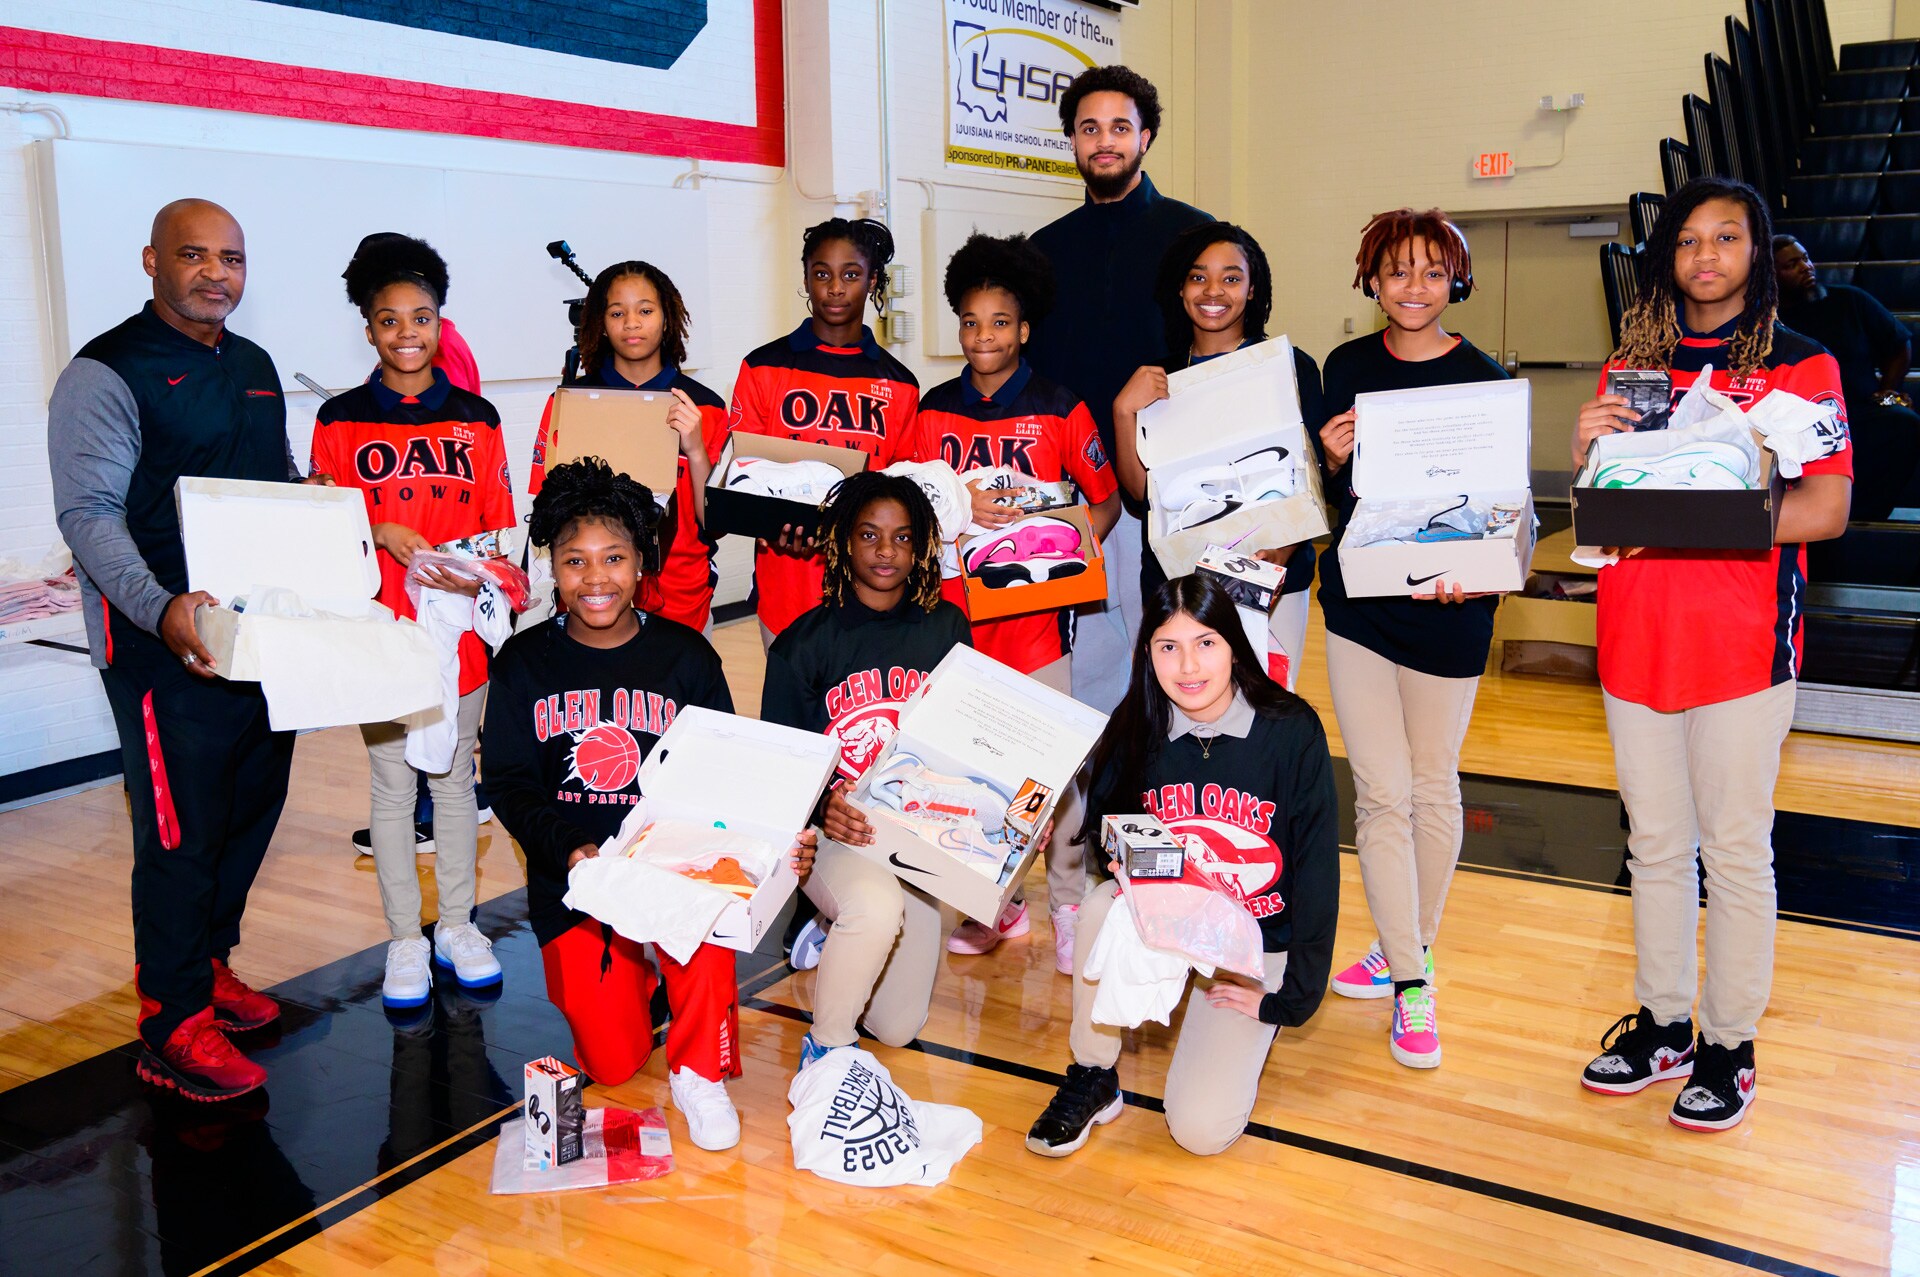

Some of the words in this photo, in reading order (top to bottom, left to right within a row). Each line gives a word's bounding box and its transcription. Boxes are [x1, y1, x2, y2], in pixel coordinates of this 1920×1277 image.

[1002, 0, 1060, 30] Member
[1064, 11, 1078, 35] of
[955, 123, 993, 140] LOUISIANA
[995, 130, 1013, 143] HIGH
[1014, 132, 1042, 147] SCHOOL
[994, 153, 1005, 169] by
[1006, 155, 1052, 173] PROPANE
[1480, 152, 1509, 176] EXIT
[780, 388, 889, 440] OAK
[1015, 422, 1043, 436] ELITE
[355, 437, 475, 483] OAK
[940, 432, 1038, 479] OAK
[825, 668, 883, 719] GLEN
[533, 688, 601, 743] GLEN
[1201, 783, 1276, 834] OAKS
[843, 1132, 910, 1173] 2023
